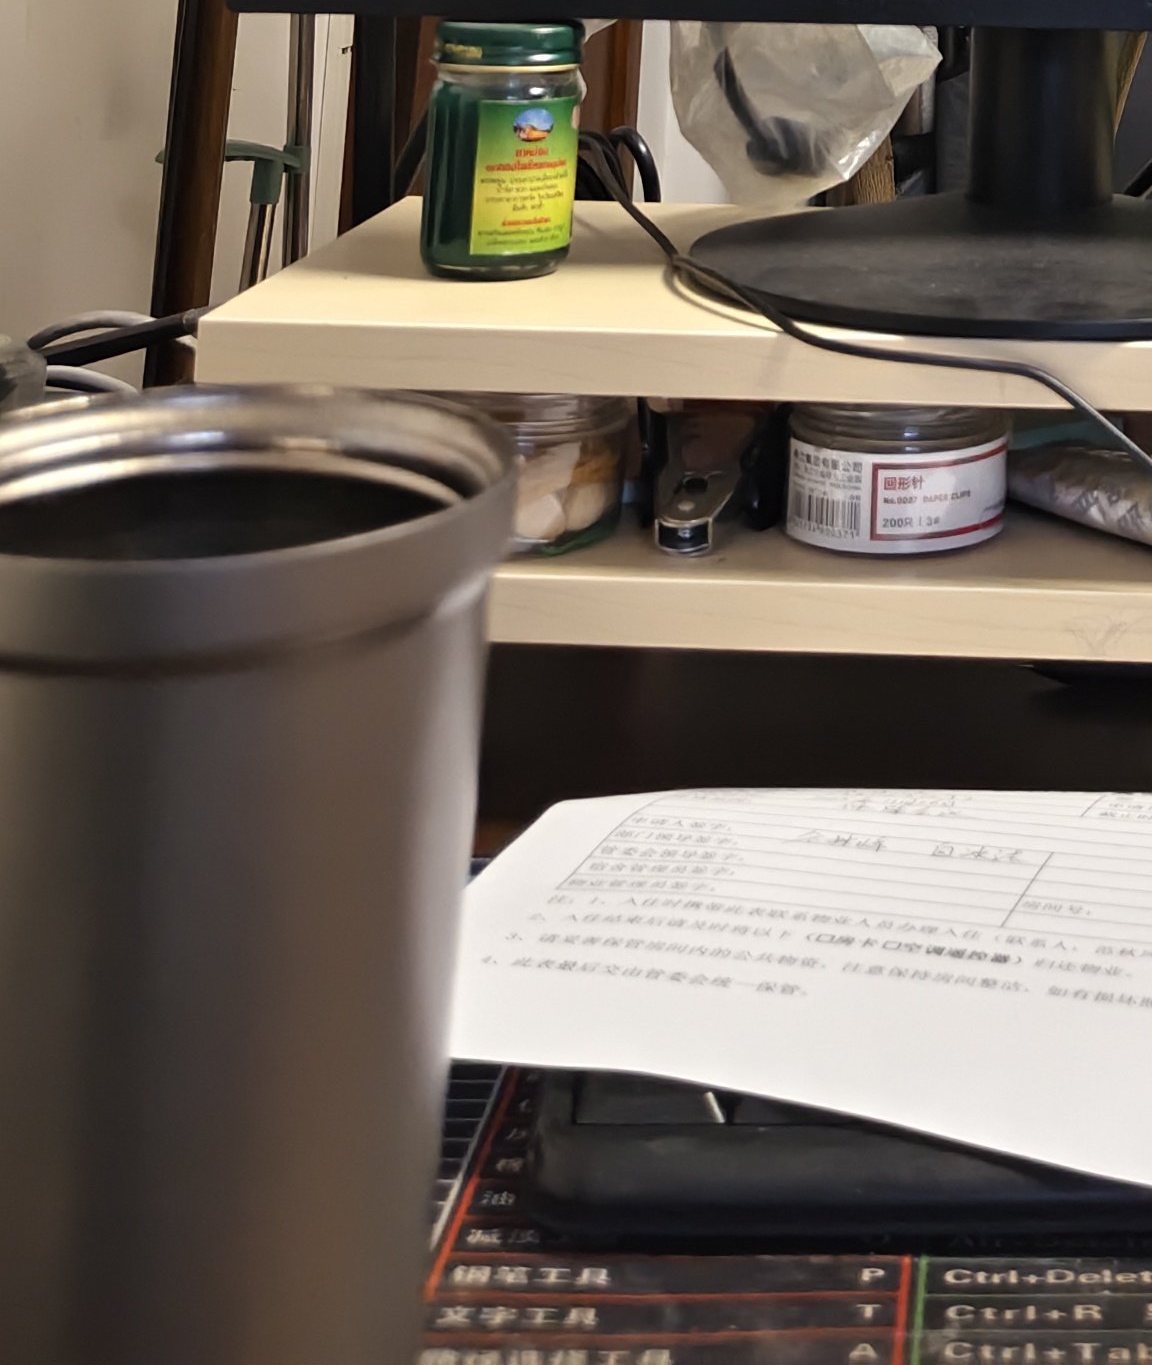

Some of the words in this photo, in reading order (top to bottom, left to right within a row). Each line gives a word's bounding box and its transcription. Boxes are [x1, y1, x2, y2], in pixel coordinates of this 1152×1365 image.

[451, 1264, 613, 1287] 钢笔工具
[860, 1268, 886, 1283] P
[433, 1305, 600, 1329] 文字工具
[855, 1303, 882, 1320] T
[944, 1303, 1105, 1321] Ctrl+R
[847, 1341, 880, 1362] A
